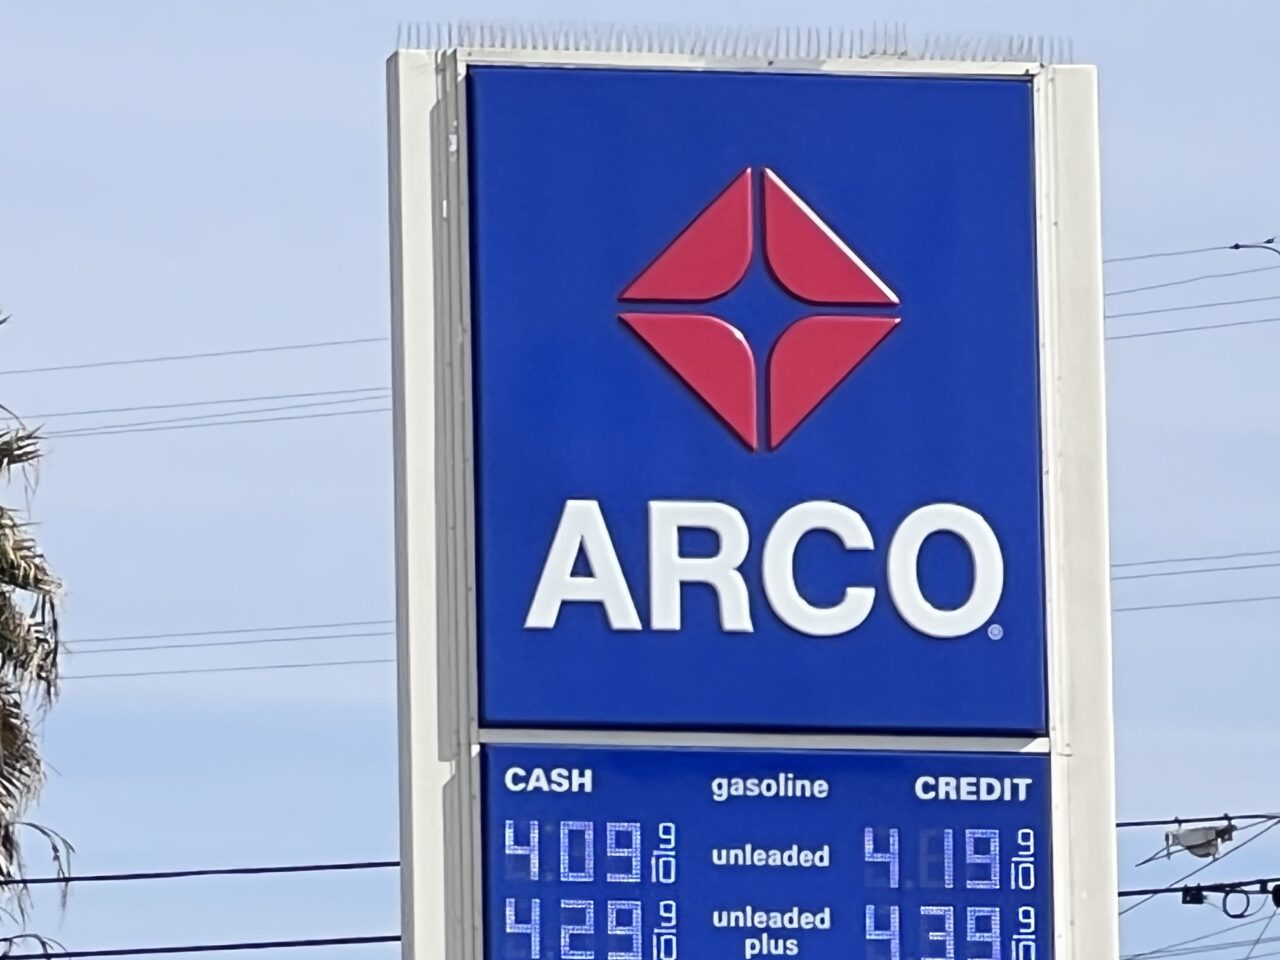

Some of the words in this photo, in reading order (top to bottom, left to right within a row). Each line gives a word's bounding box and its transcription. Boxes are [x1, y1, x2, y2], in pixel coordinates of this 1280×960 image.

[523, 498, 1005, 638] ARCO
[504, 767, 593, 793] CASH
[711, 773, 830, 801] gasoline
[915, 776, 1033, 801] CREDIT
[712, 843, 830, 868] unleaded
[713, 906, 831, 930] unleaded
[744, 934, 799, 956] plus
